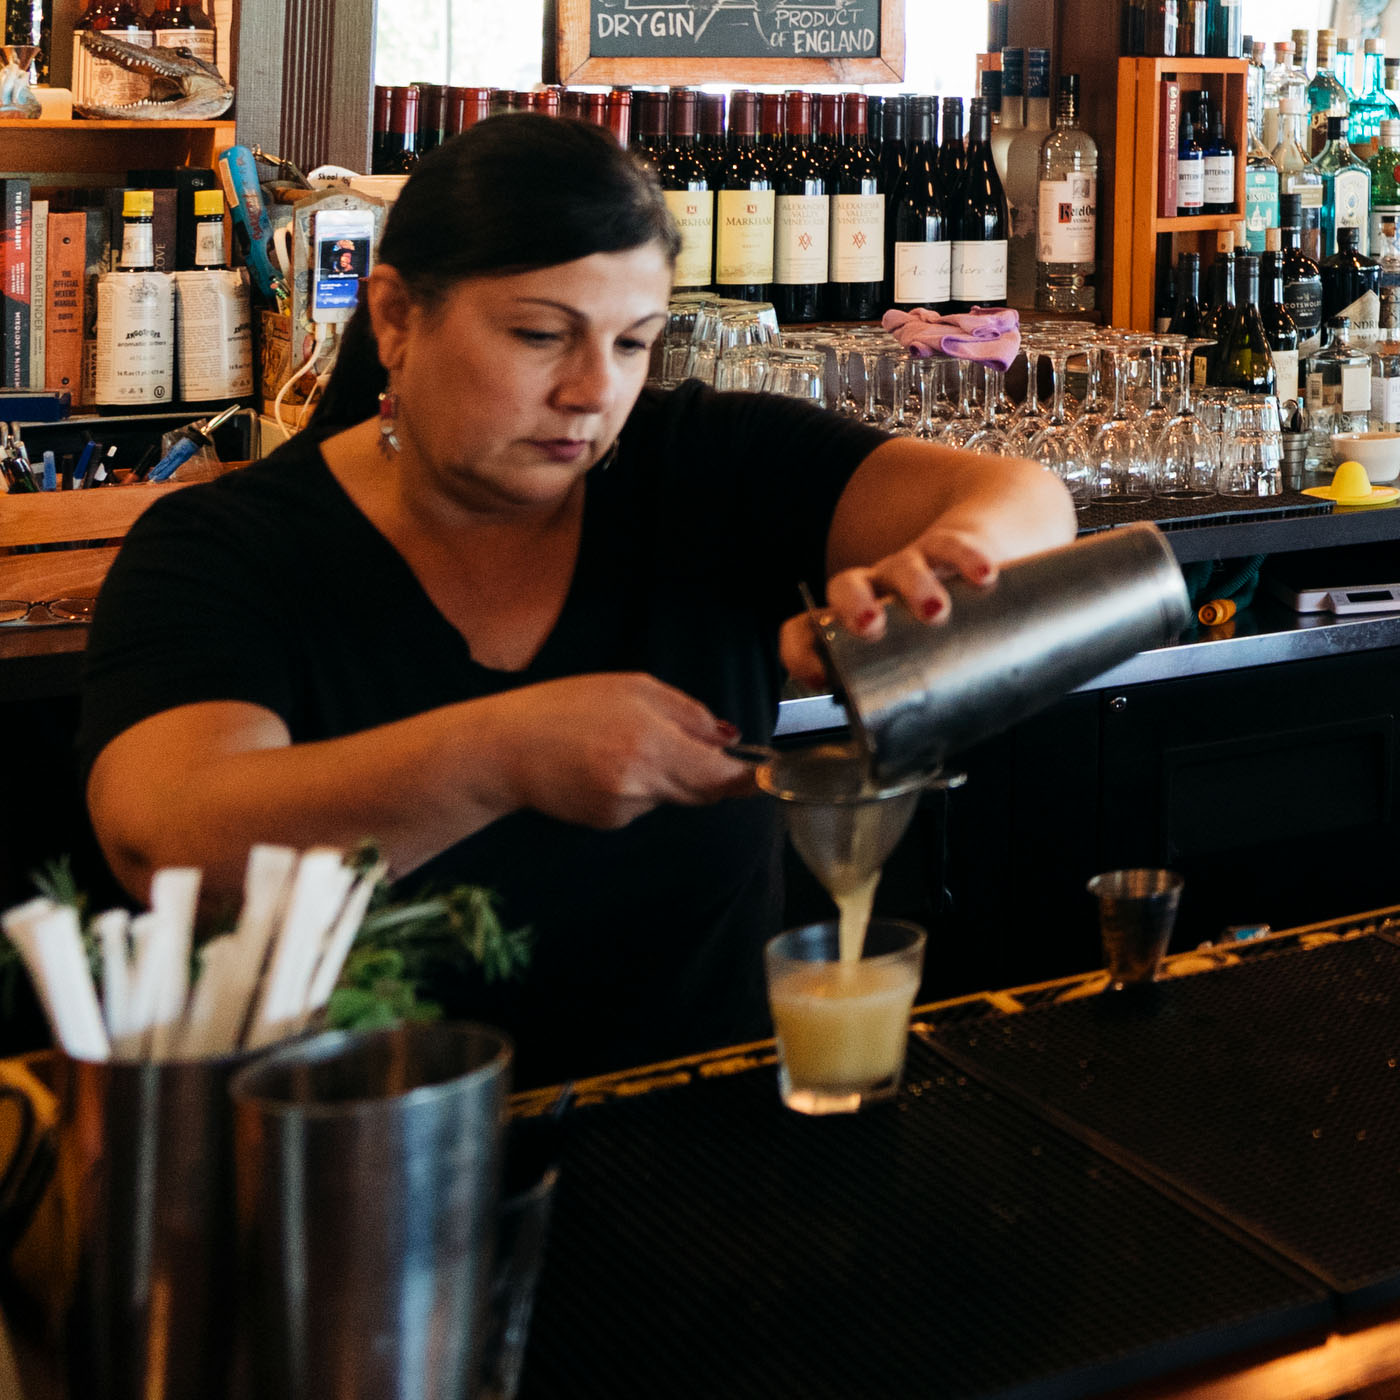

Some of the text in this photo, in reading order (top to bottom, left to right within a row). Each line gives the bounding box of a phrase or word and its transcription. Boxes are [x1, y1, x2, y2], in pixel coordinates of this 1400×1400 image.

[598, 10, 695, 38] DRY GIN
[775, 8, 864, 29] PRODUCT
[770, 29, 876, 53] OF ENGLAND
[676, 217, 712, 227] ARKHAM
[34, 223, 43, 332] BOURBON BARTENDER
